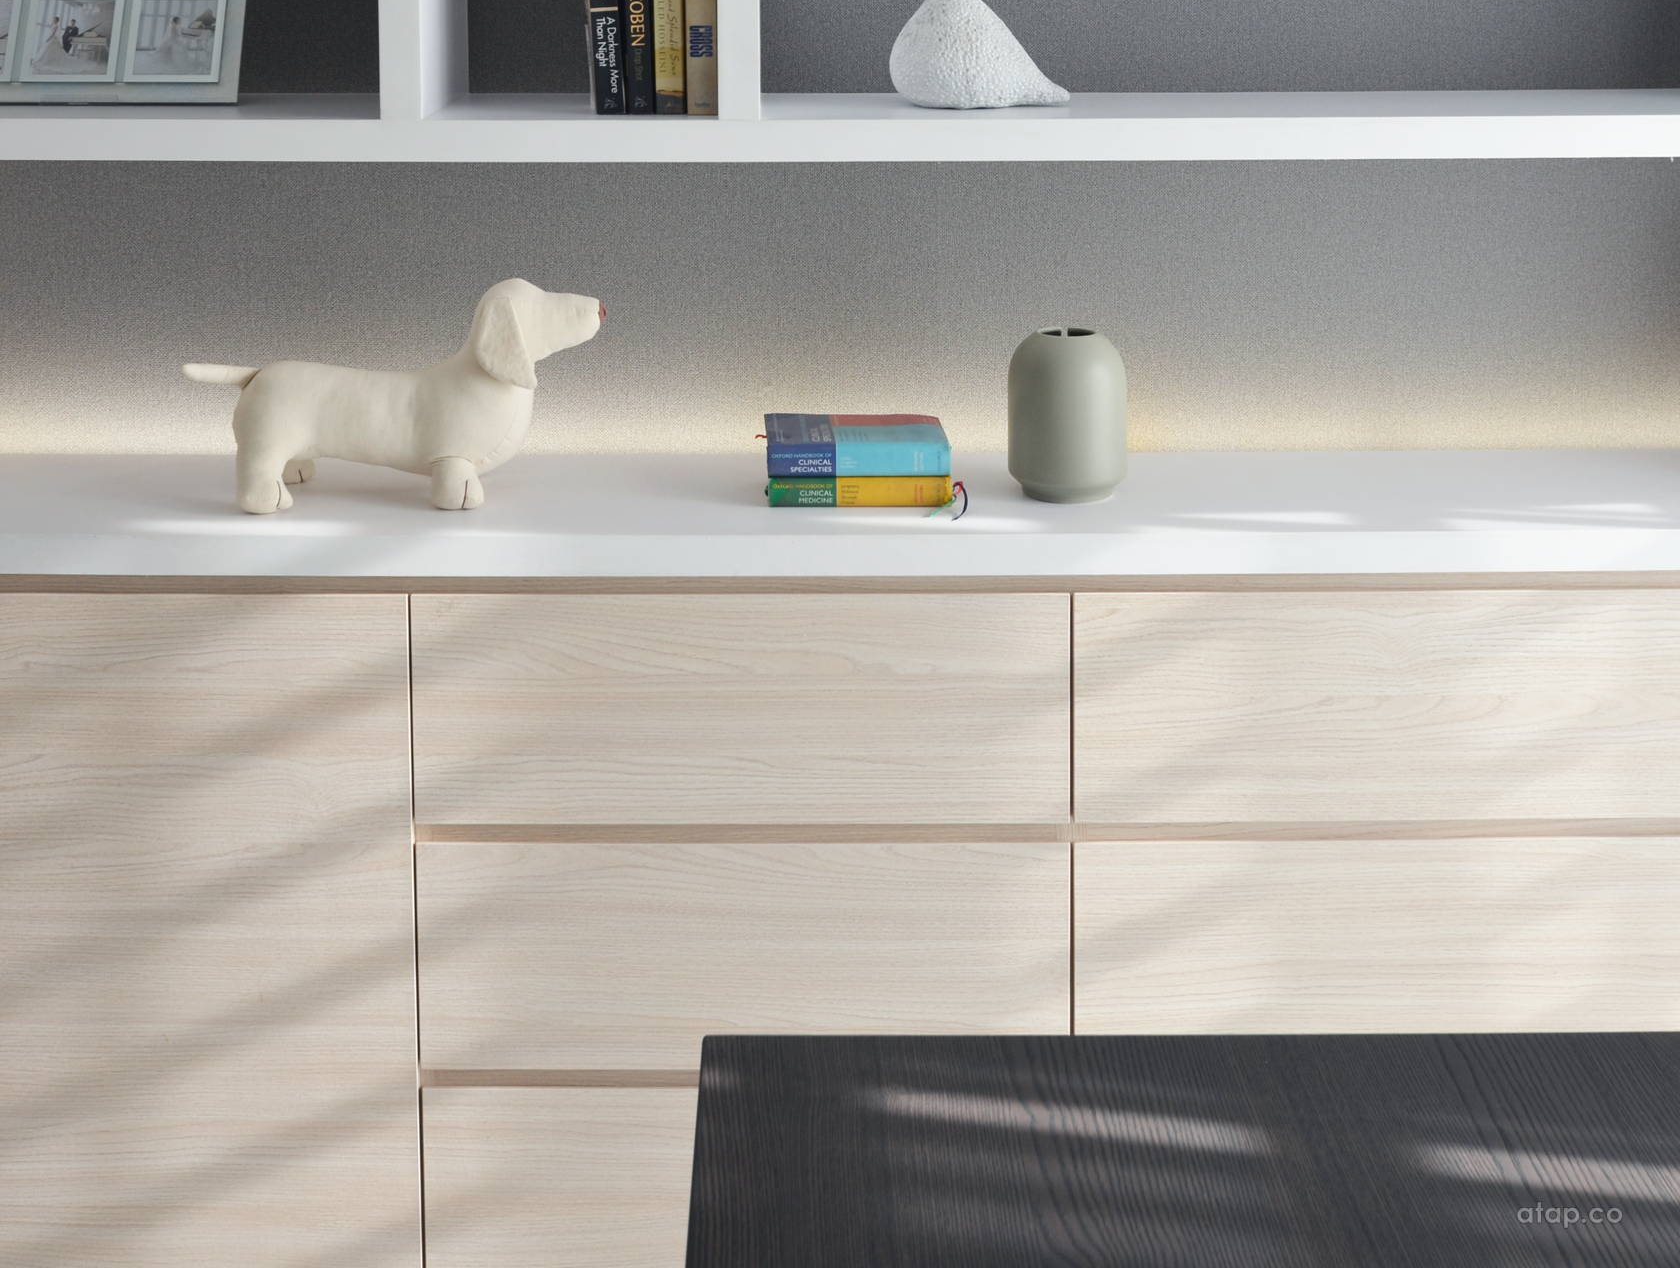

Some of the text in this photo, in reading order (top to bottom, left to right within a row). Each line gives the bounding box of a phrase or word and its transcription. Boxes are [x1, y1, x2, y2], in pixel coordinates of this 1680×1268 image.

[595, 17, 607, 67] Than Night
[606, 16, 618, 93] A Darkness More
[689, 25, 713, 58] CROSS
